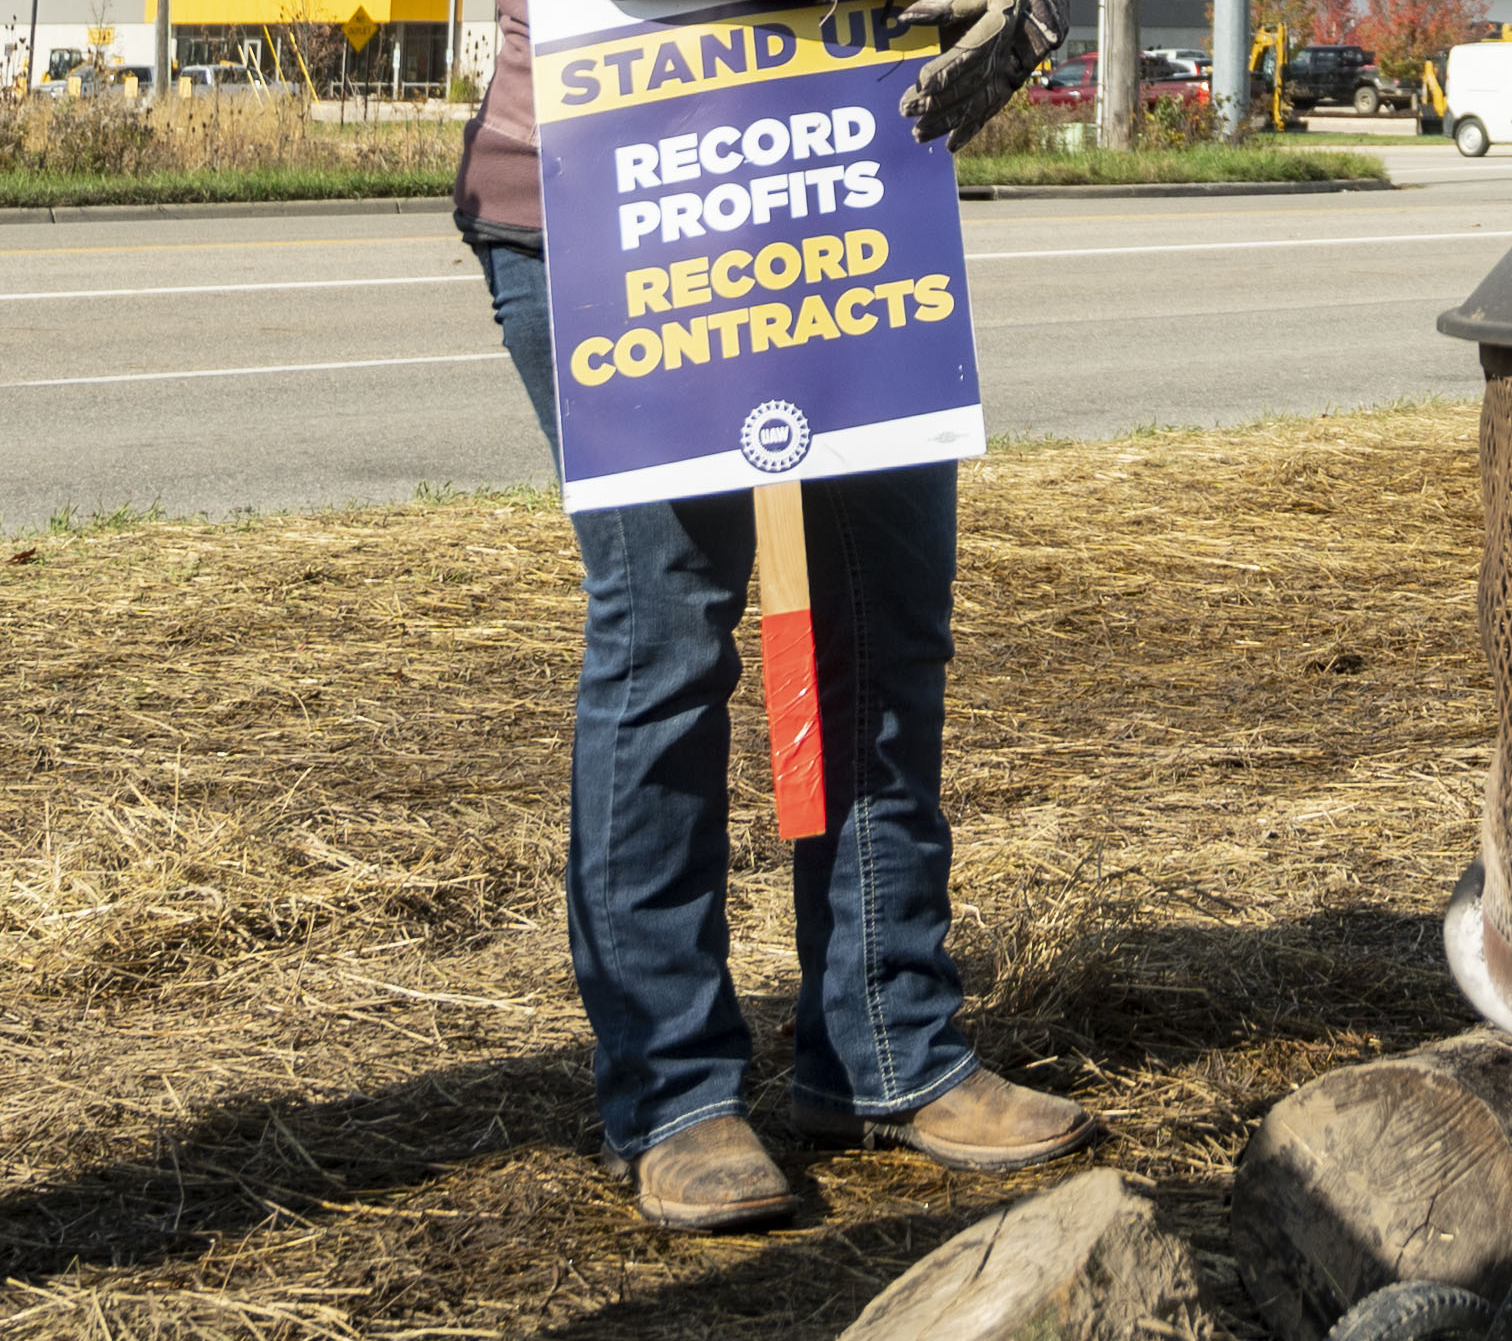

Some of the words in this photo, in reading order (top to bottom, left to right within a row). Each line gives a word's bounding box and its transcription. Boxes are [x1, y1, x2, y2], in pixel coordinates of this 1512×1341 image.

[559, 21, 798, 107] STAND
[819, 6, 912, 59] UP
[616, 105, 877, 194] RECORD
[619, 160, 885, 252] PROFITS
[625, 228, 890, 318] RECORD
[569, 273, 956, 387] CONTRACTS
[760, 425, 790, 445] UAW
